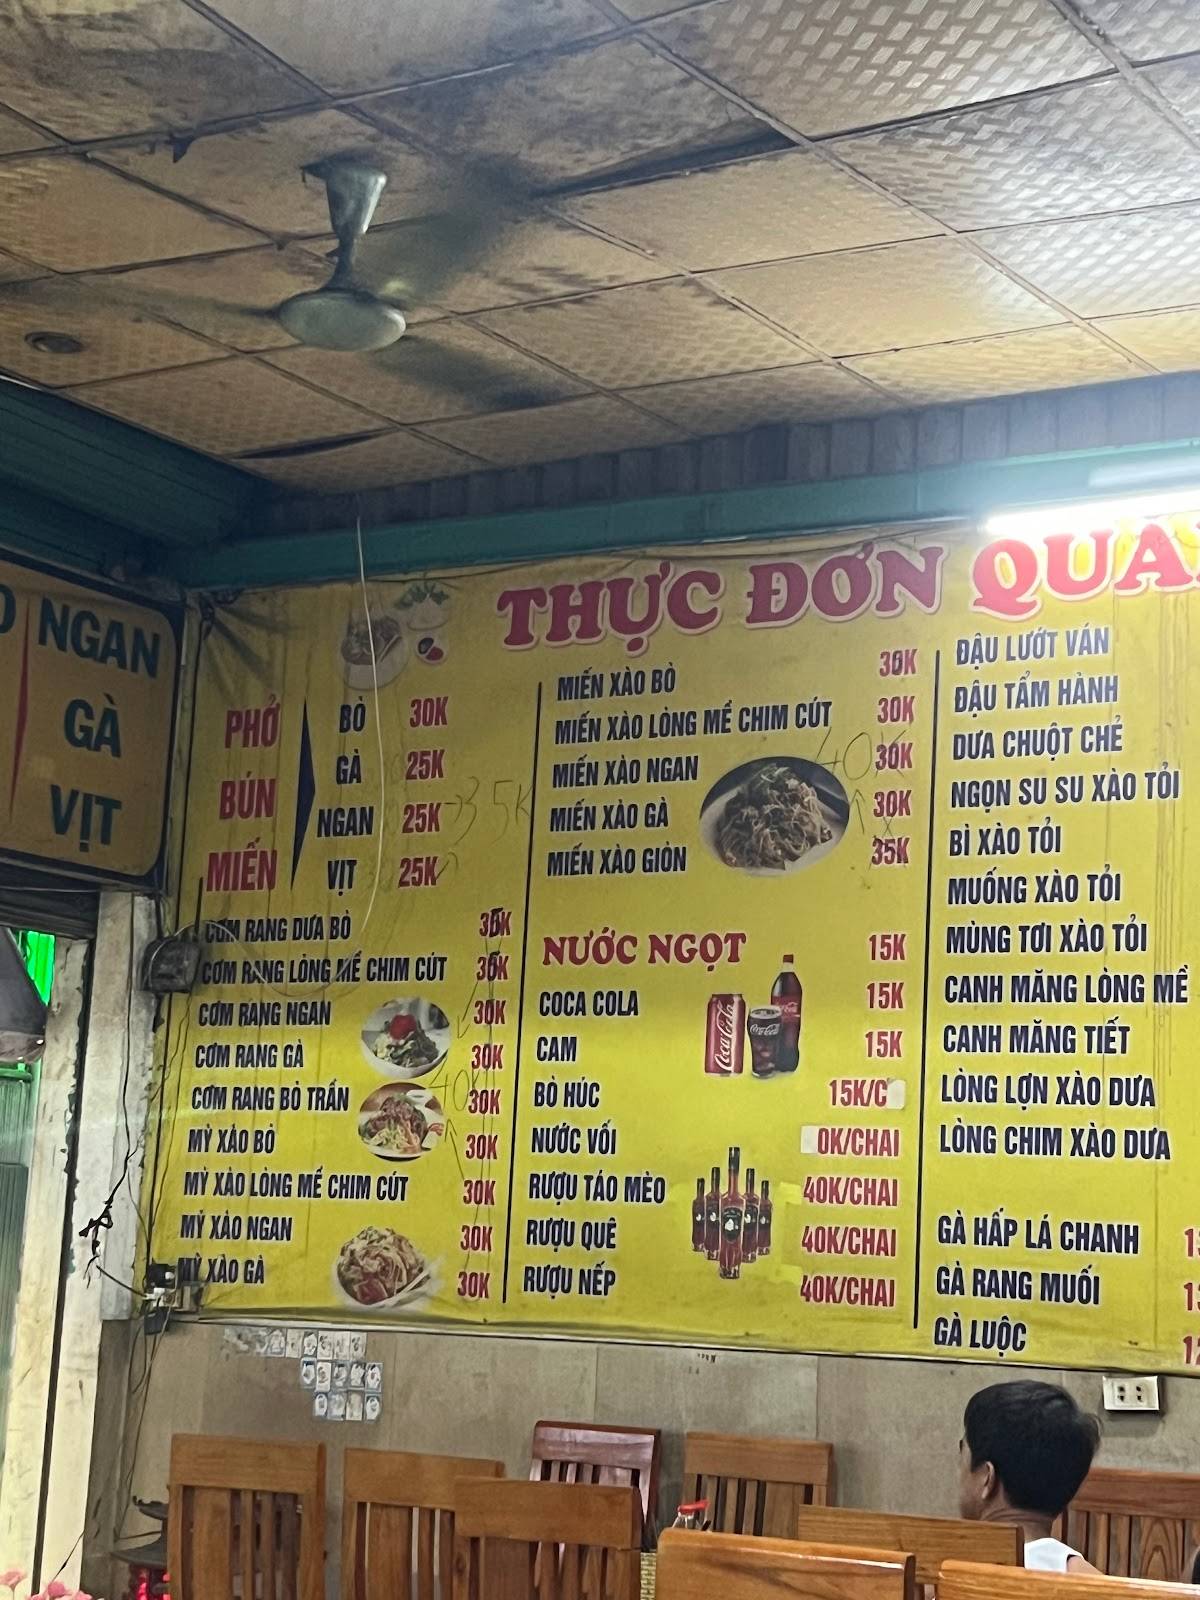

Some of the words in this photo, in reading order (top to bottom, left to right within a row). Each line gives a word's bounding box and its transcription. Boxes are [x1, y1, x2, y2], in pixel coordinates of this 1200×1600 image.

[495, 559, 723, 655] THỰC
[745, 540, 947, 628] ĐƠN
[971, 521, 1200, 619] QUA
[38, 597, 161, 679] NGAN
[956, 632, 999, 671] ĐẬU
[1006, 627, 1058, 662] LƯỚT
[1065, 622, 1110, 657] VÁN
[557, 667, 604, 701] MIẾN
[609, 666, 645, 698] XÀO
[651, 661, 676, 694] BÒ
[954, 679, 997, 718] ĐẬU
[1004, 670, 1050, 709] TẨM
[64, 693, 122, 758] GÀ
[225, 694, 281, 748] PHỞ
[339, 696, 367, 733] BÒ
[409, 696, 448, 728] 30K
[555, 711, 601, 745] MIẾN
[607, 710, 643, 741] XÀO
[648, 706, 697, 739] LÒNG
[738, 704, 789, 733] CHIM
[795, 697, 833, 729] CÚT
[877, 695, 916, 724] 30K
[952, 729, 995, 761] DƯA
[1003, 722, 1074, 761] CHUỘT
[1080, 714, 1123, 754] CHẺ
[336, 749, 362, 784] GÀ
[406, 749, 445, 780] 25K
[552, 754, 599, 789] MIẾN
[604, 754, 641, 786] XÀO
[647, 755, 699, 784] NGAN
[875, 742, 914, 771] 30K
[219, 771, 276, 820] BÚN
[873, 789, 912, 818] 30K
[951, 779, 1011, 814] NGỌN
[1018, 777, 1047, 806] SU
[1055, 775, 1084, 804] SU
[1091, 767, 1137, 802] XÀO
[1144, 761, 1180, 799] TỎI
[50, 784, 122, 853] VỊT
[317, 806, 374, 837] NGAN
[402, 803, 441, 833] 25K
[550, 798, 597, 832] MIẾN
[602, 798, 638, 830] XÀO
[644, 796, 669, 828] GÀ
[871, 836, 910, 866] 35K
[949, 823, 970, 857] BÌ
[977, 822, 1021, 856] XÀO
[1027, 816, 1062, 854] TỎI
[206, 837, 278, 892] MIẾN
[398, 856, 438, 888] 25K
[547, 842, 594, 877] MIẾN
[600, 843, 636, 874] XÀO
[642, 841, 687, 873] GIÒN
[328, 859, 358, 896] VỊT
[947, 866, 1027, 905] MUỐNG
[1034, 868, 1079, 903] XÀO
[1086, 863, 1121, 902] TỎI
[204, 918, 240, 943] CƠM
[245, 917, 287, 942] RANG
[292, 914, 324, 940] DƯA
[330, 910, 351, 940] BÒ
[946, 920, 1011, 954] MÙNG
[1018, 921, 1052, 953] TƠI
[1059, 918, 1105, 953] XÀO
[1112, 913, 1148, 952] TỎI
[542, 926, 638, 966] NƯỚC
[648, 932, 747, 972] NGỌT
[868, 933, 907, 961] 15K
[202, 958, 236, 984] CƠM
[242, 959, 284, 984] RANG
[289, 954, 330, 983] LÒNG
[367, 957, 409, 981] CHIM
[415, 952, 447, 981] CÚT
[945, 975, 1003, 1003] CANH
[1011, 969, 1078, 1003] MĂNG
[1085, 966, 1145, 1003] LÒNG
[1153, 964, 1189, 1003] MỀ
[199, 1000, 233, 1026] CƠM
[239, 1002, 281, 1026] RANG
[286, 1001, 331, 1026] NGAN
[474, 999, 507, 1026] 30K
[539, 990, 587, 1017] COCA
[592, 990, 639, 1016] COLA
[866, 982, 905, 1009] 15K
[536, 1036, 577, 1062] CAM
[865, 1030, 903, 1058] 15K
[943, 1025, 1002, 1054] CANH
[1009, 1019, 1077, 1054] MĂNG
[1083, 1016, 1131, 1054] TIẾT
[195, 1043, 230, 1068] CƠM
[235, 1044, 278, 1068] RANG
[283, 1039, 304, 1068] GÀ
[471, 1043, 504, 1070] 30K
[192, 1085, 227, 1110] CƠM
[232, 1086, 275, 1111] RANG
[468, 1089, 501, 1115] 30K
[534, 1075, 558, 1108] BÒ
[563, 1076, 601, 1108] HÚC
[829, 1079, 888, 1108] 15K/C
[941, 1067, 998, 1103] LÒNG
[1005, 1073, 1048, 1111] LỢN
[1055, 1070, 1101, 1106] XÀO
[1109, 1074, 1156, 1107] DƯA
[465, 1134, 498, 1160] 30K
[531, 1122, 581, 1154] NƯỚC
[587, 1119, 617, 1155] VỐI
[817, 1127, 900, 1157] 0K/CHAI
[940, 1117, 997, 1154] LÒNG
[1004, 1126, 1063, 1156] CHIM
[1070, 1122, 1116, 1158] XÀO
[1124, 1128, 1171, 1160] DƯA
[250, 1167, 293, 1198] LÒNG
[328, 1174, 371, 1200] CHIM
[376, 1171, 409, 1202] CÚT
[463, 1179, 496, 1206] 30K
[529, 1170, 578, 1206] RƯỢU
[583, 1169, 618, 1202] TÁO
[624, 1170, 666, 1204] MÈO
[803, 1176, 898, 1207] 40K/CHAI
[247, 1215, 293, 1241] NGAN
[460, 1224, 493, 1252] 30K
[526, 1217, 576, 1253] RƯỢU
[581, 1217, 617, 1251] QUÊ
[801, 1225, 897, 1257] 40K/CHAI
[938, 1209, 966, 1245] GÀ
[973, 1207, 1018, 1247] HẤP
[1025, 1213, 1052, 1249] LÁ
[1060, 1221, 1139, 1255] CHANH
[206, 1254, 239, 1284] XÀO
[243, 1254, 265, 1284] GÀ
[457, 1271, 490, 1299] 30K
[523, 1264, 573, 1300] RƯỢU
[578, 1260, 616, 1296] NẾP
[936, 1260, 965, 1296] GÀ
[972, 1268, 1032, 1300] RANG
[1040, 1264, 1100, 1305] MUỐI
[800, 1274, 895, 1307] 40K/CHAI
[934, 1311, 962, 1347] GÀ
[969, 1315, 1027, 1357] LUỘC
